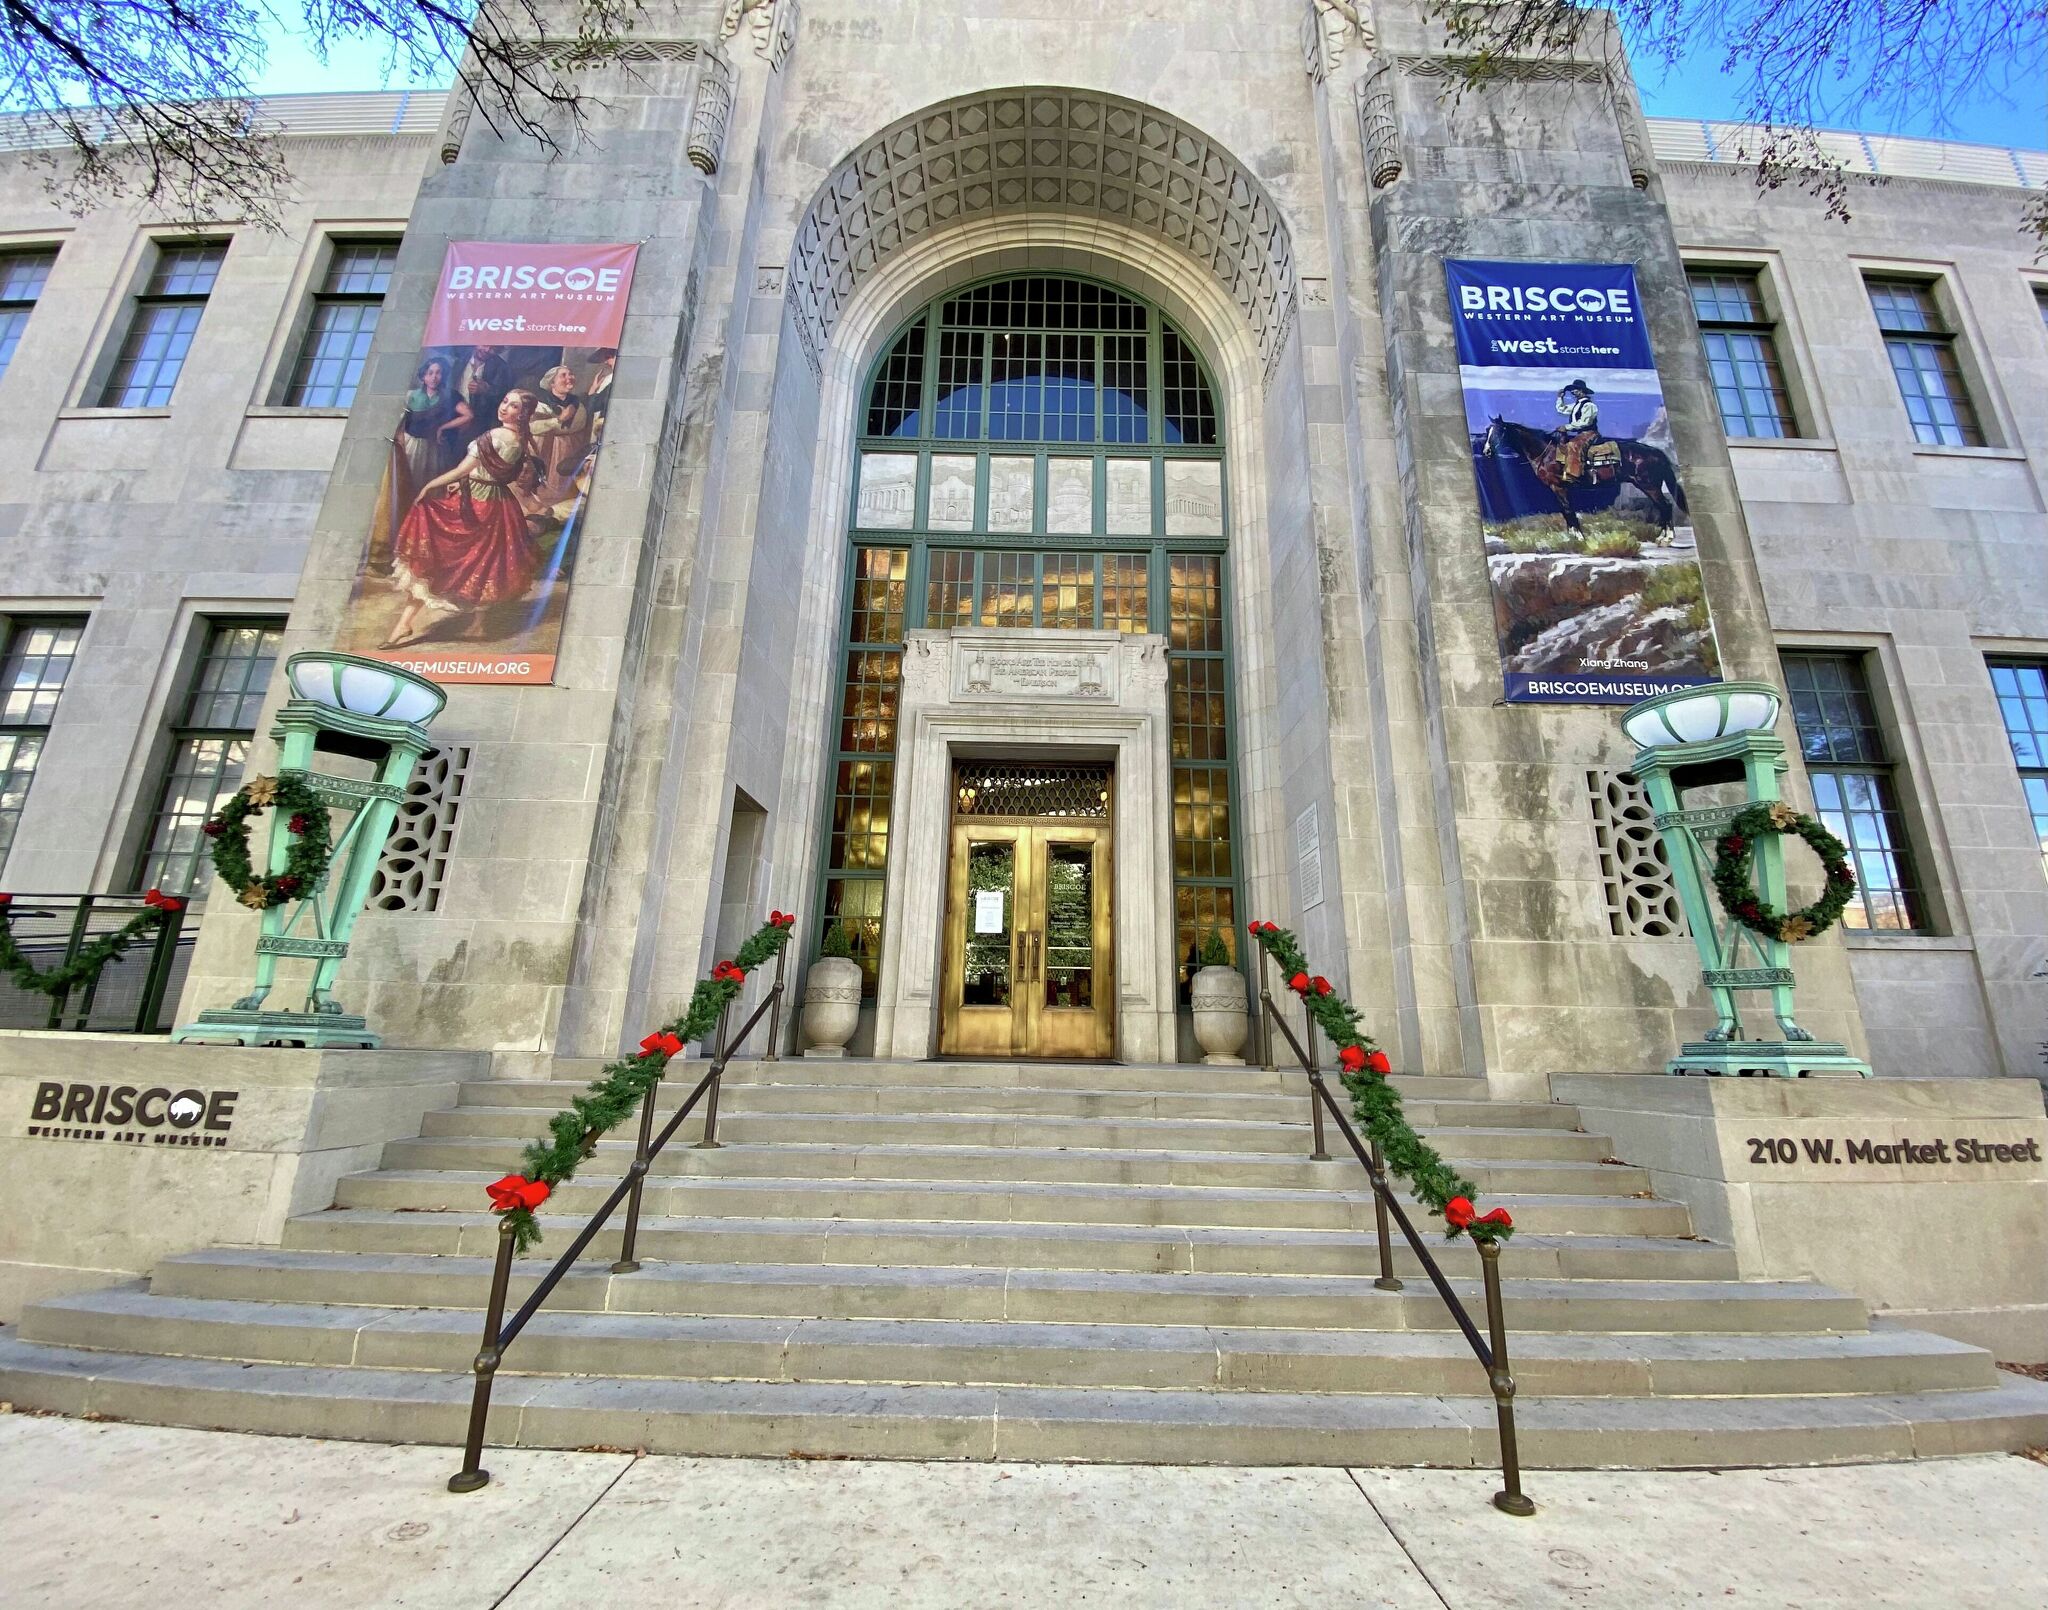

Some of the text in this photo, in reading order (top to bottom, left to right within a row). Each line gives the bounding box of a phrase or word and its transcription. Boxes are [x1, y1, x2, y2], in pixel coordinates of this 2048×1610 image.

[449, 265, 621, 292] BRISCOE
[554, 293, 615, 302] MUSEUM
[1460, 285, 1632, 313] BRISCOE
[467, 315, 527, 332] west
[526, 324, 557, 332] starts
[558, 324, 587, 333] here
[1464, 312, 1634, 323] WESTERN ART MUSEUM
[1497, 337, 1559, 354] west
[1559, 345, 1590, 354] starts
[1591, 345, 1620, 355] here
[385, 660, 530, 675] OEMUSEUM.ORG
[1579, 657, 1648, 670] Xiang Zhang
[1528, 681, 1692, 696] BRISCOEMUSEUMO
[31, 1082, 239, 1130] BRISCOE
[28, 1126, 228, 1147] WESTERN ART MUSEUM
[1747, 1138, 2042, 1165] 210 W. Market Street
